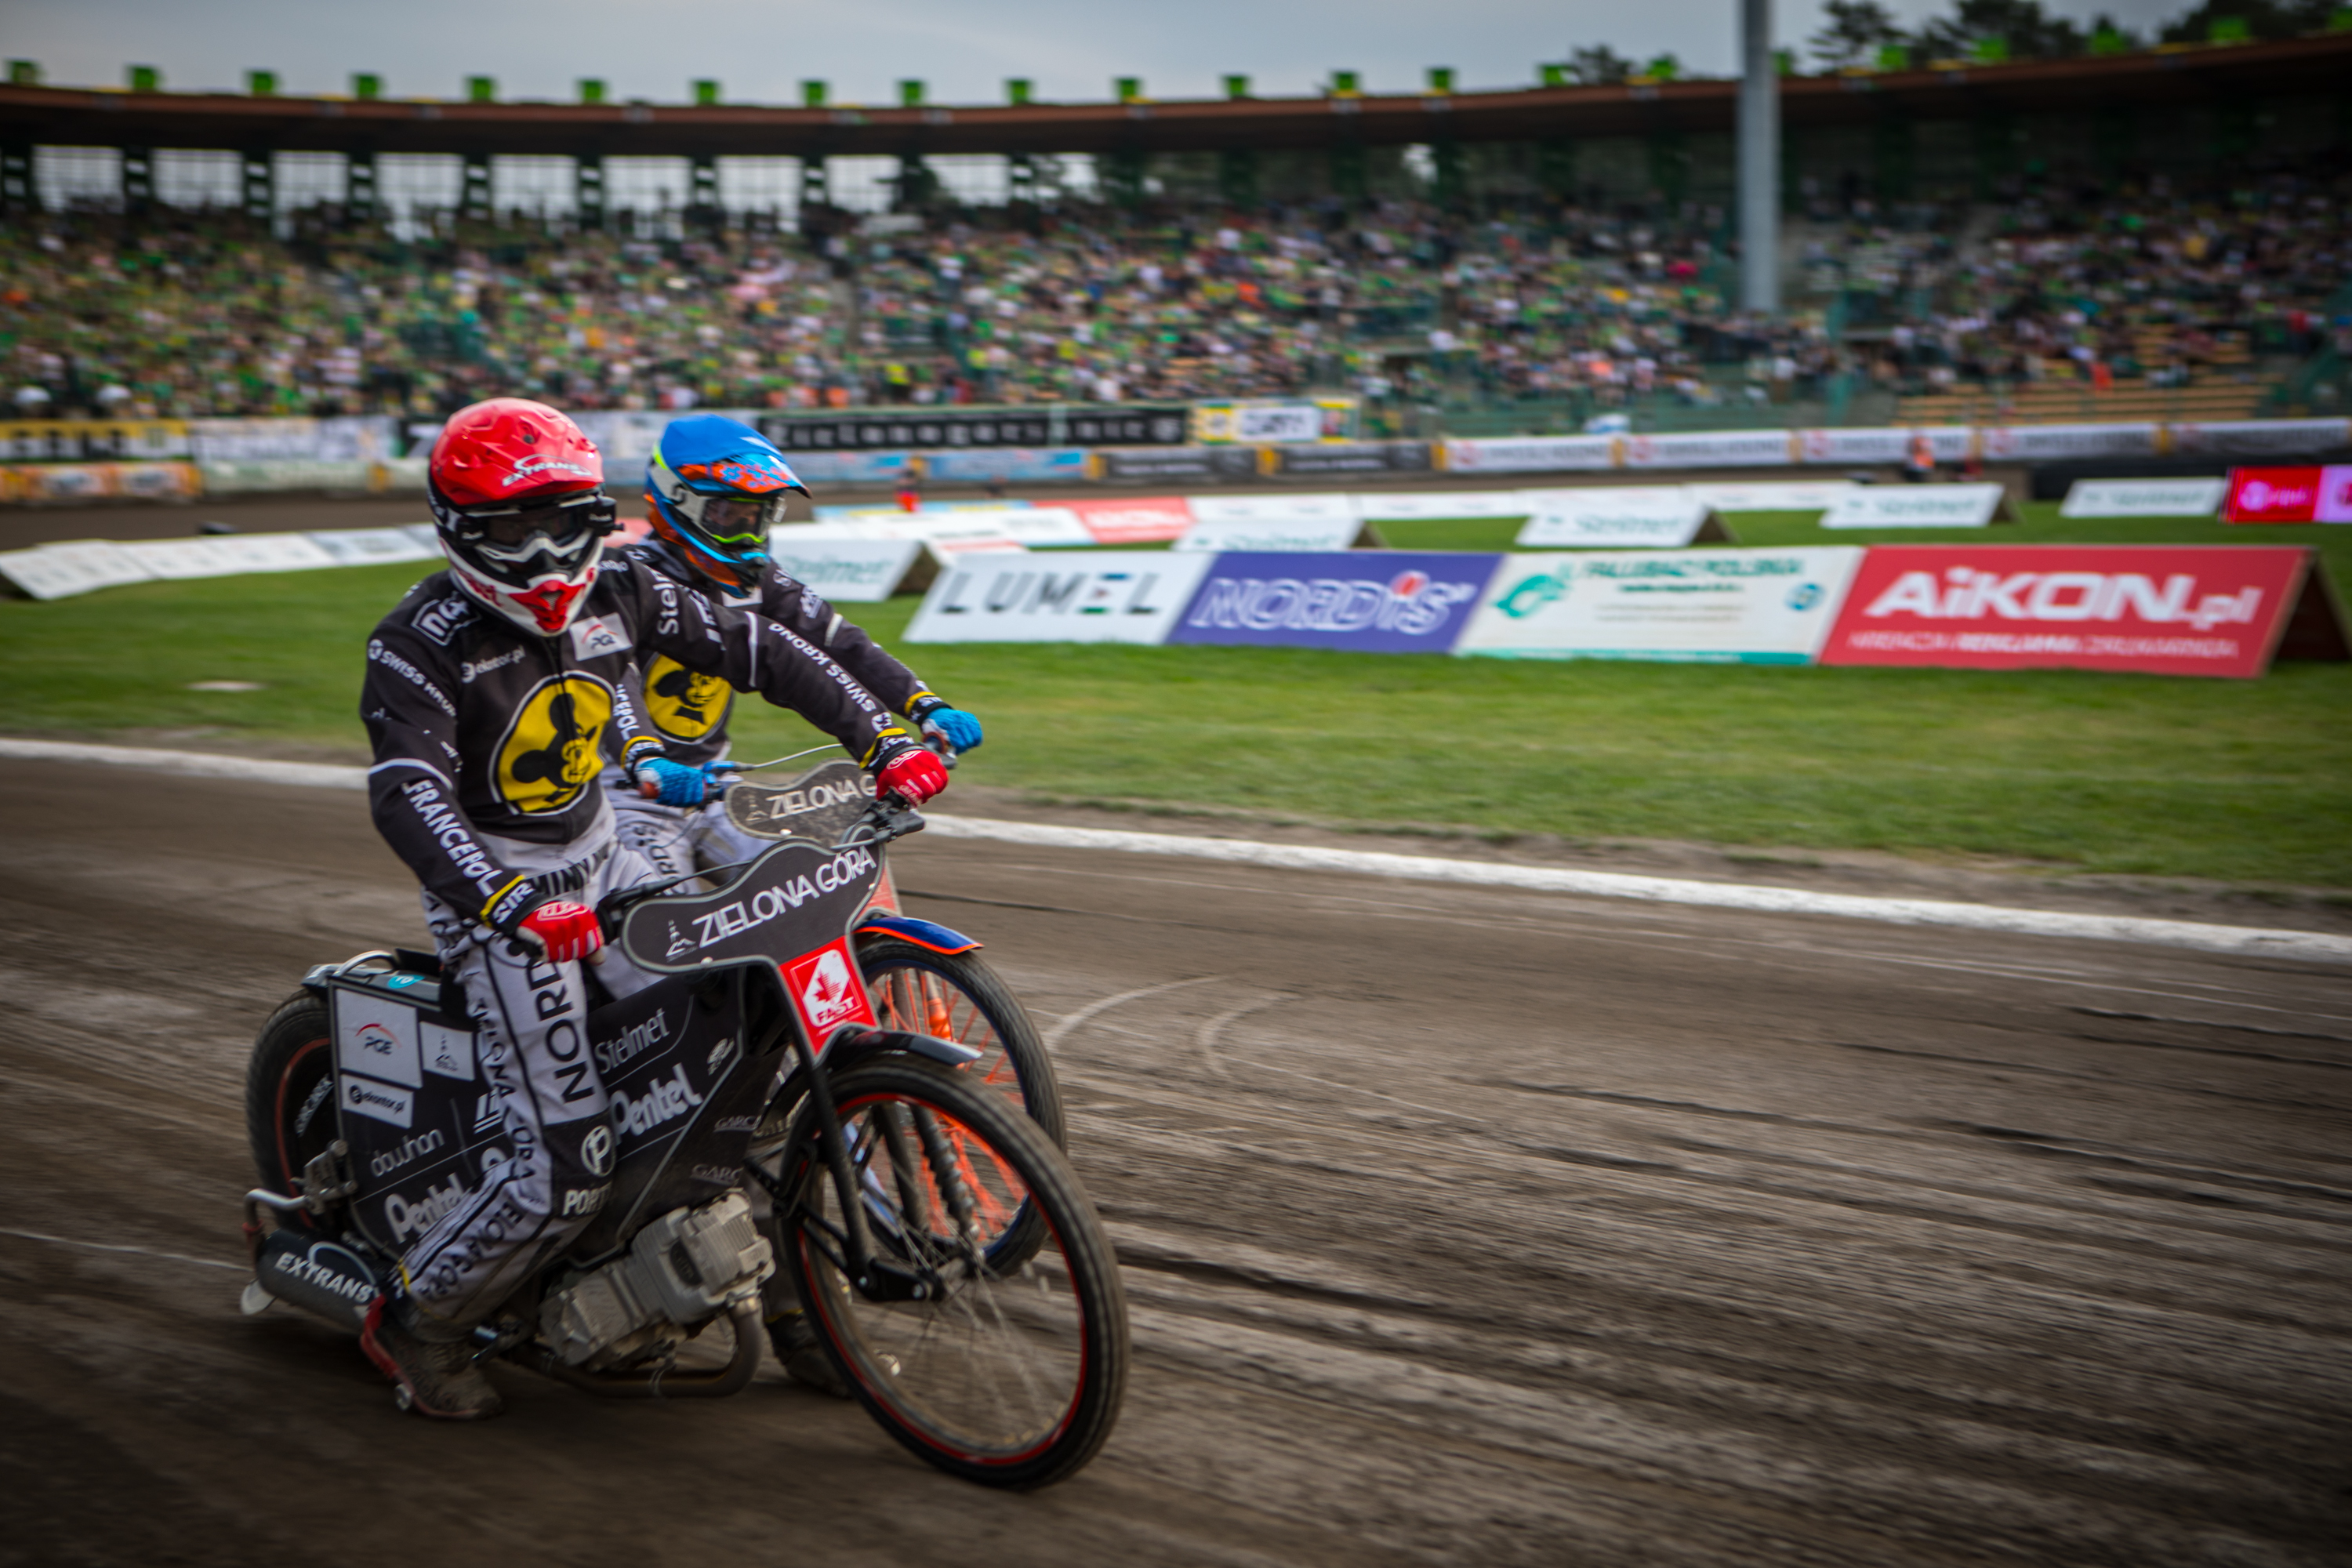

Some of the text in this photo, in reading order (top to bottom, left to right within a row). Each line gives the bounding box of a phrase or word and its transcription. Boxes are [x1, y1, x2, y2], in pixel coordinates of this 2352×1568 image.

[652, 564, 680, 635] Stel
[941, 572, 1161, 615] LUMEL
[379, 650, 426, 685] SWISS
[768, 622, 877, 712] SWISS KRONO
[765, 779, 863, 820] ZIELONA
[691, 874, 820, 948] ZIELONA
[815, 845, 877, 894] GÓRA
[594, 1008, 670, 1075] Stelmet
[816, 996, 855, 1024] FAST
[609, 1062, 704, 1147] Pentel
[384, 1172, 466, 1245] Pentel
[274, 1251, 376, 1304] EXTRANS
